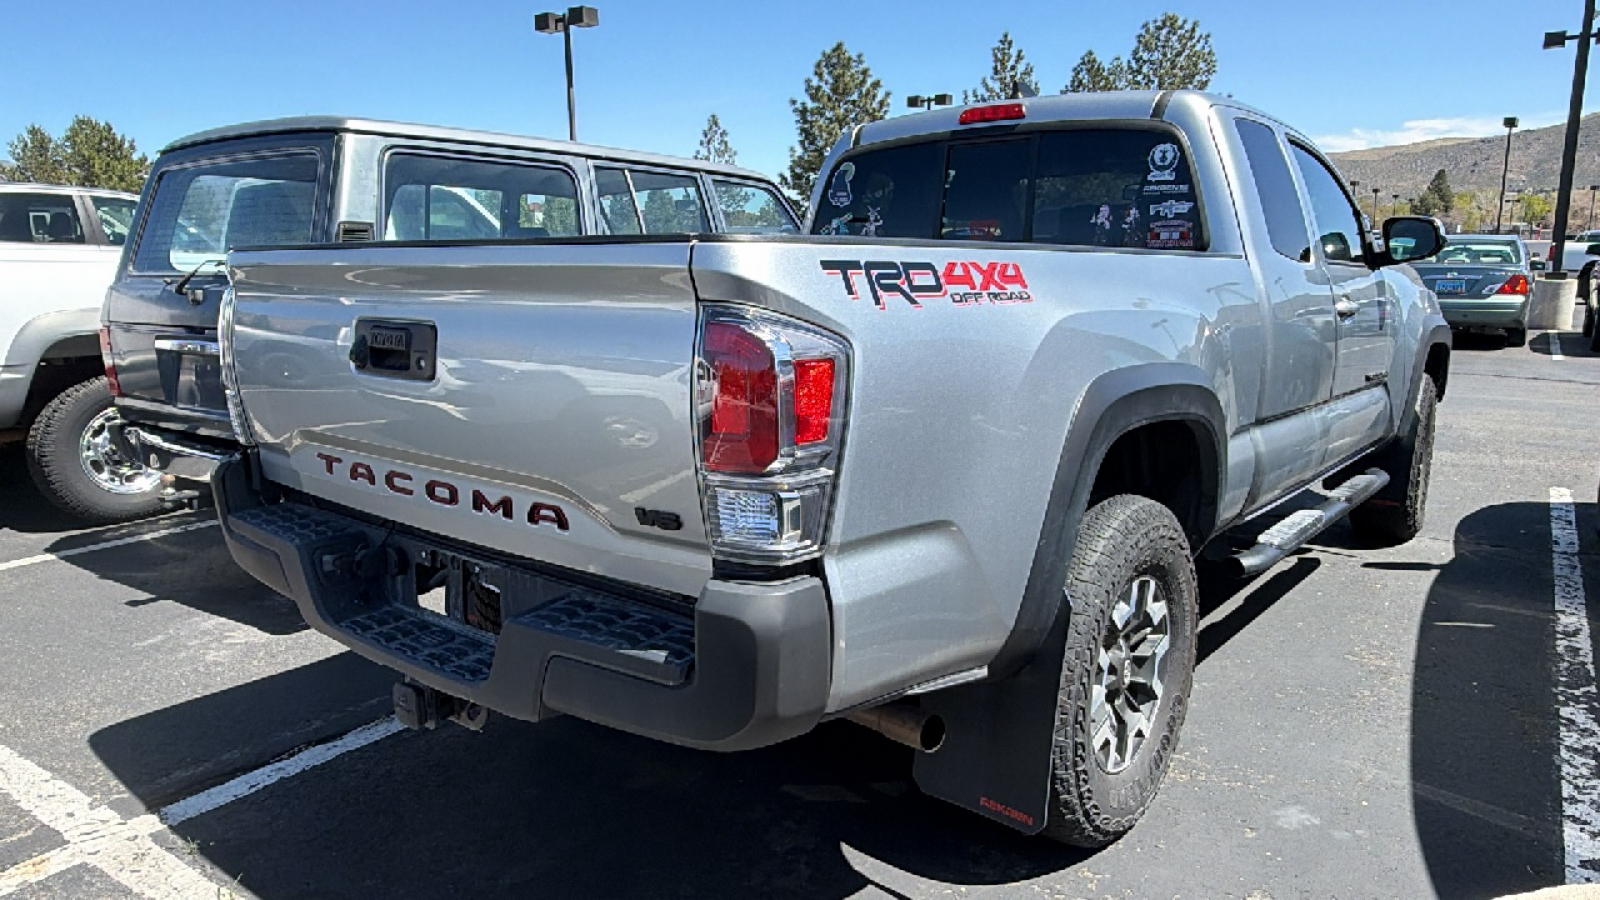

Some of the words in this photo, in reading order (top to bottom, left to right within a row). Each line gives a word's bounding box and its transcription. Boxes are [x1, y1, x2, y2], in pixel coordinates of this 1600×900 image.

[820, 260, 947, 309] TRD
[951, 291, 986, 306] OFF
[988, 291, 1034, 305] ROAD
[369, 331, 405, 348] TOYOTA
[315, 452, 570, 531] TACOMA
[634, 507, 683, 530] V6
